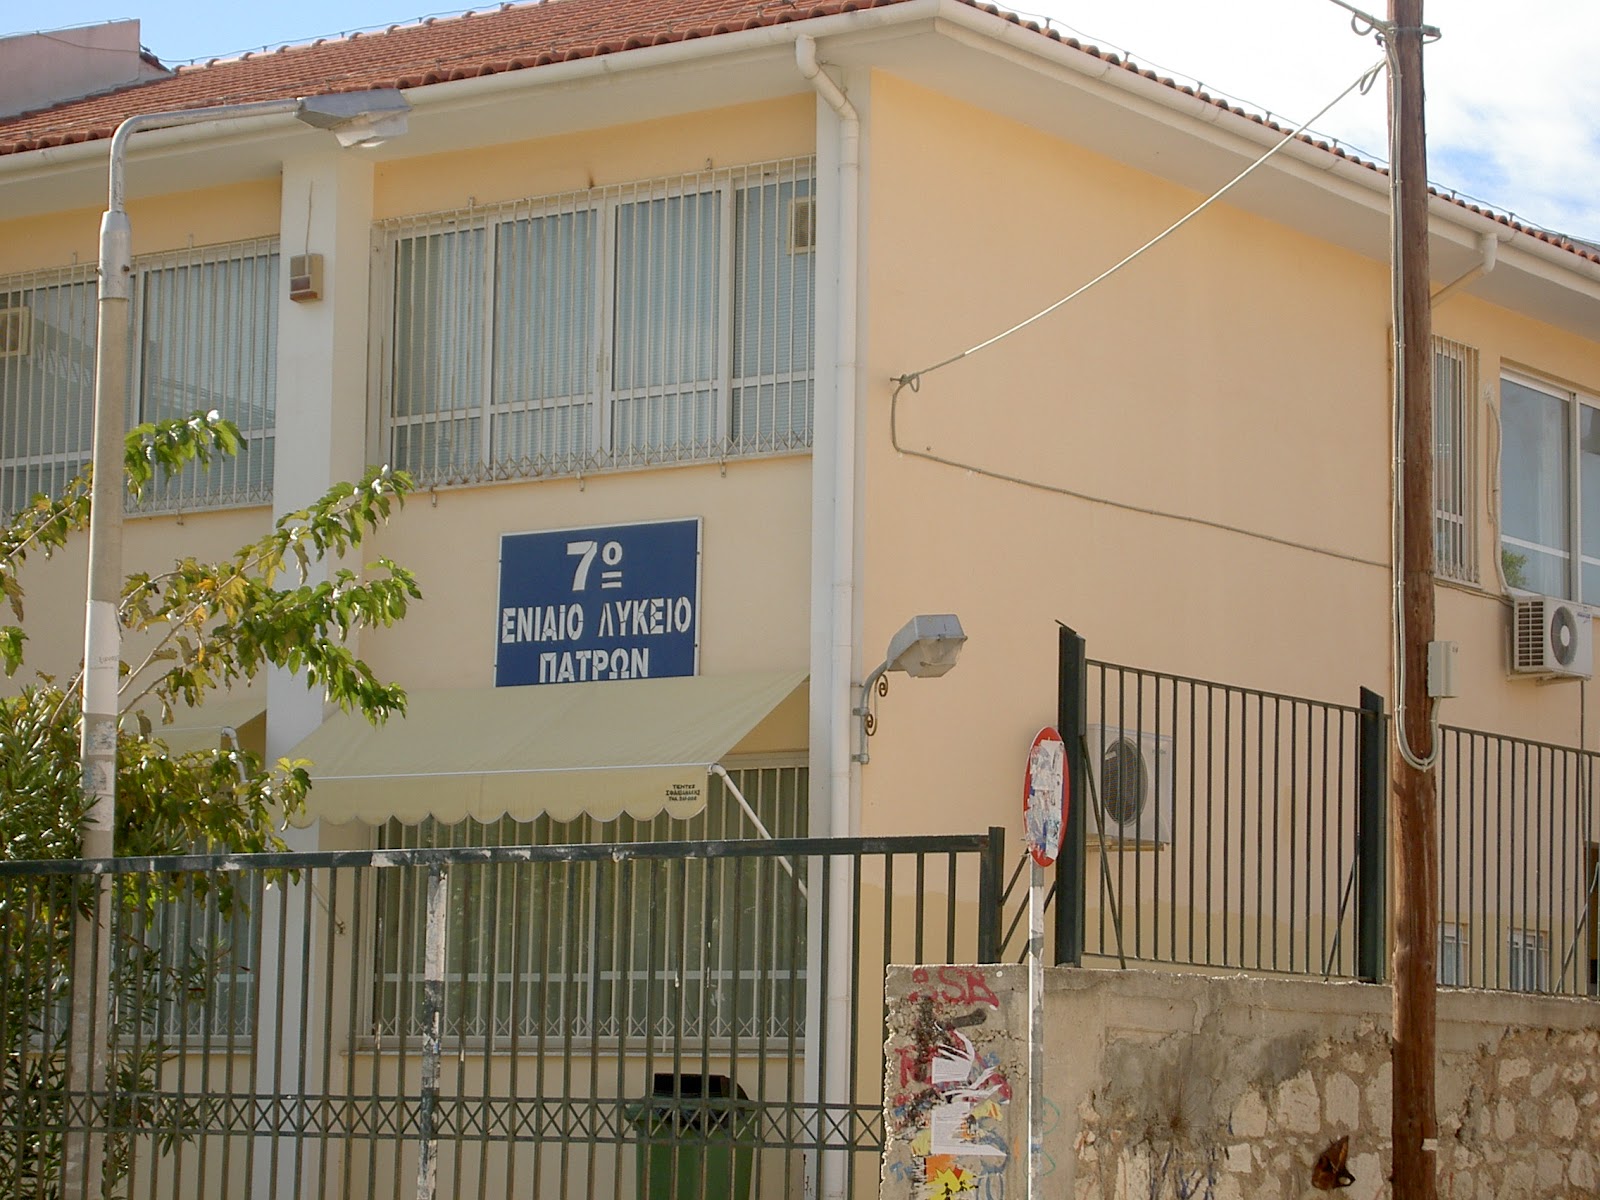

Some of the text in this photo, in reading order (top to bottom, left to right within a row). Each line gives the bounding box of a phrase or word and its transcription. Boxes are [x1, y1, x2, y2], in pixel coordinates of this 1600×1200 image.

[501, 596, 693, 644] ΕΝΙΑΙΟ ΛΥΚΕΙΟ
[538, 647, 650, 684] ΠΑΤΡΩΝ
